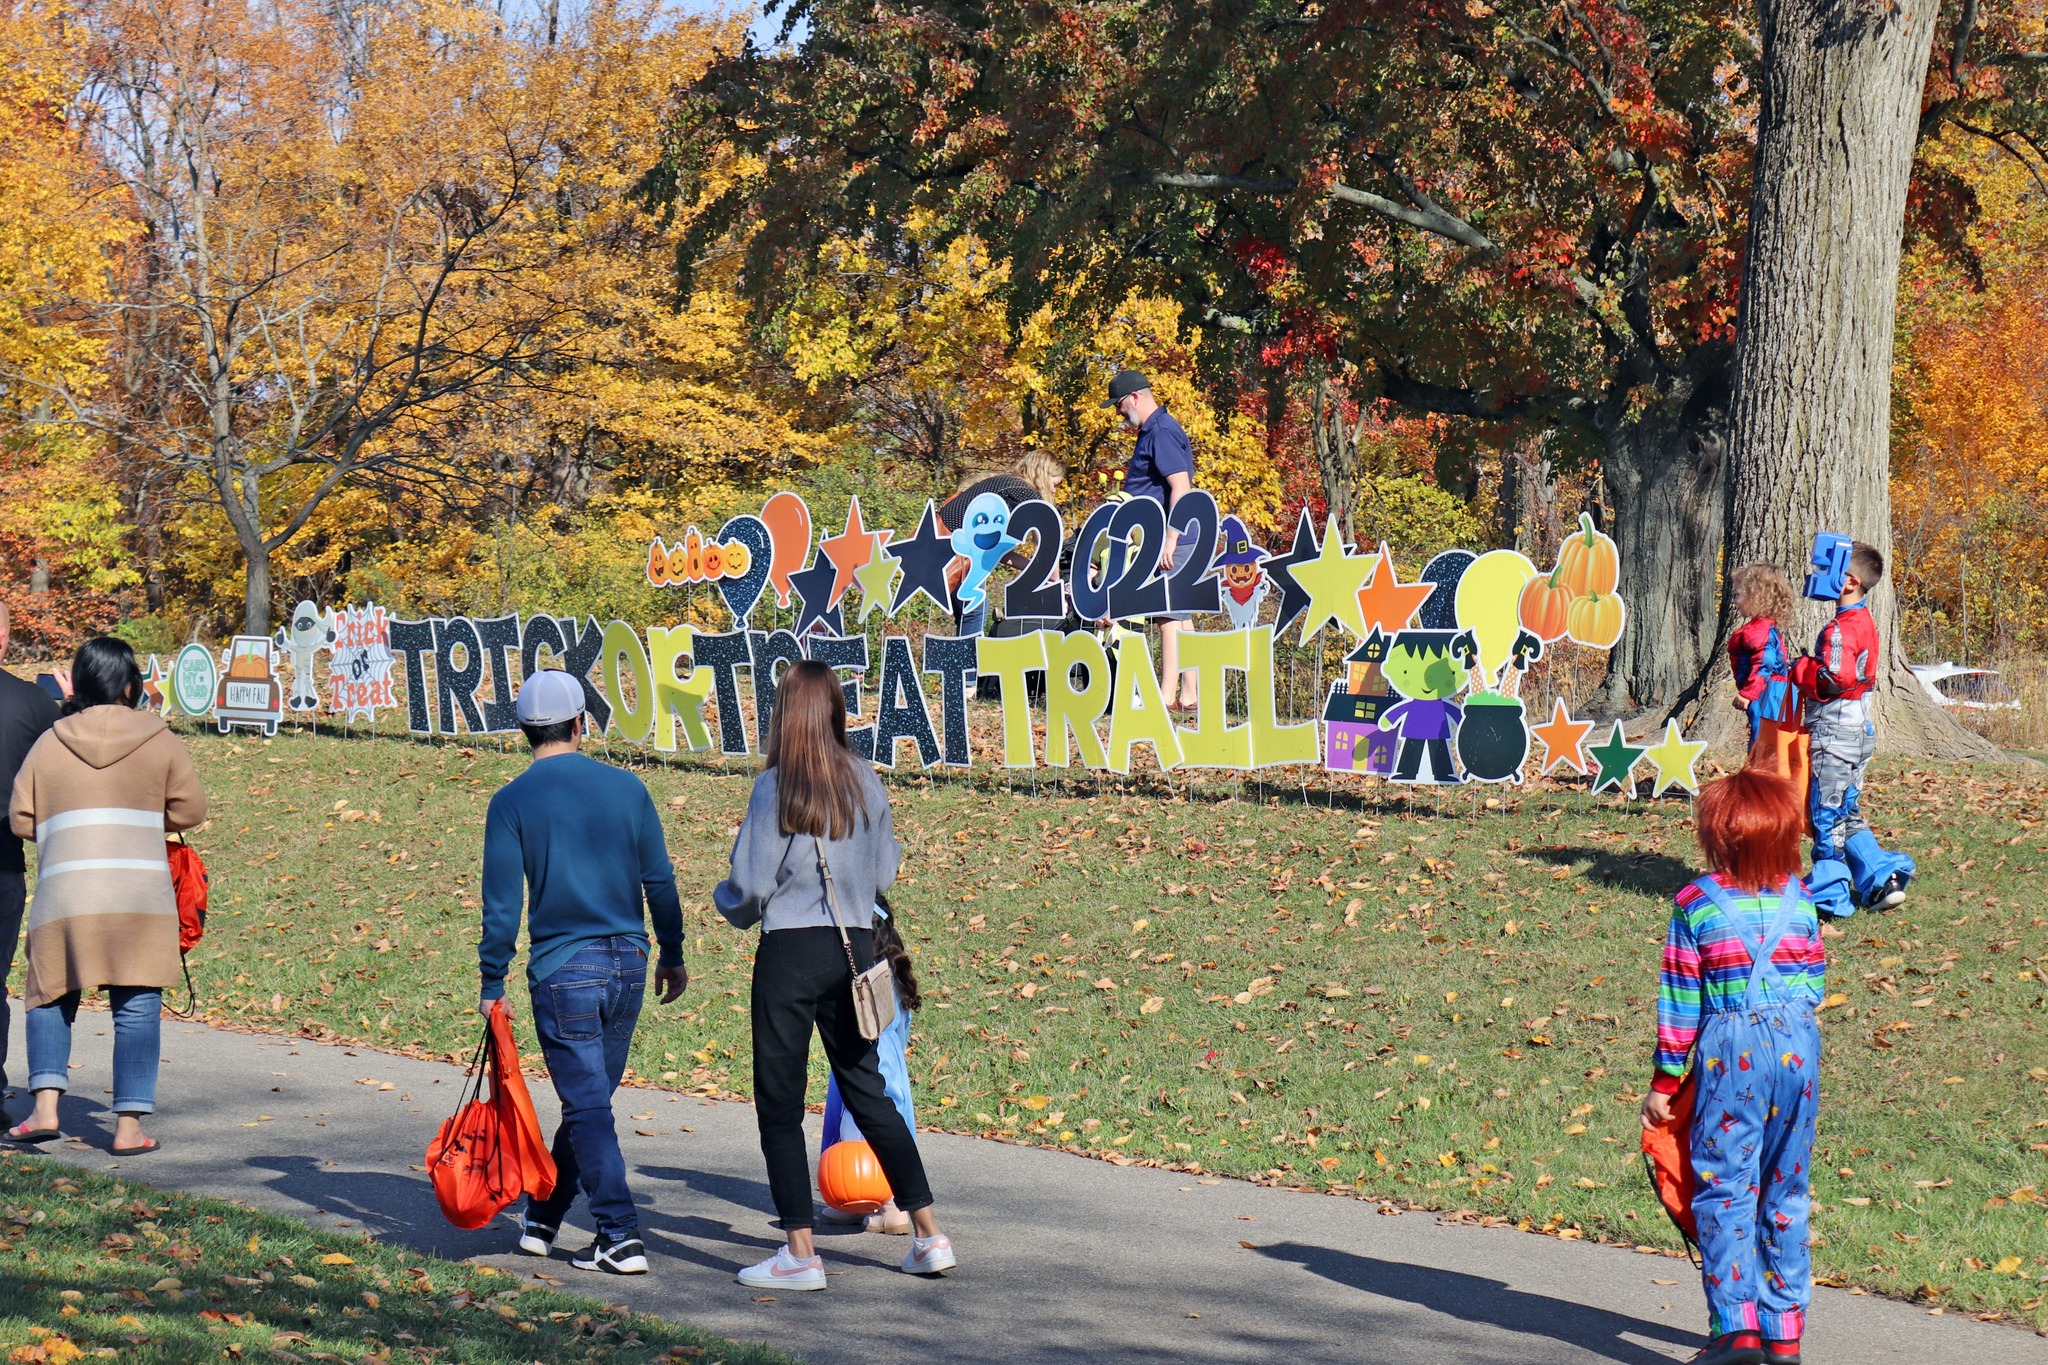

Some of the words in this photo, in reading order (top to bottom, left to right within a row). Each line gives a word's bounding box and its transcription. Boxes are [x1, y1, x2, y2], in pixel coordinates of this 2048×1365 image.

[1005, 489, 1222, 622] 2022
[182, 659, 208, 671] CARD
[352, 649, 370, 680] or
[182, 671, 197, 685] MY
[183, 684, 208, 698] YARD
[230, 686, 251, 703] HAPPY
[252, 687, 266, 704] FALL
[330, 671, 392, 710] Treat
[388, 612, 613, 737] TRICK
[602, 619, 715, 752] OR
[975, 624, 1321, 775] TRAIL
